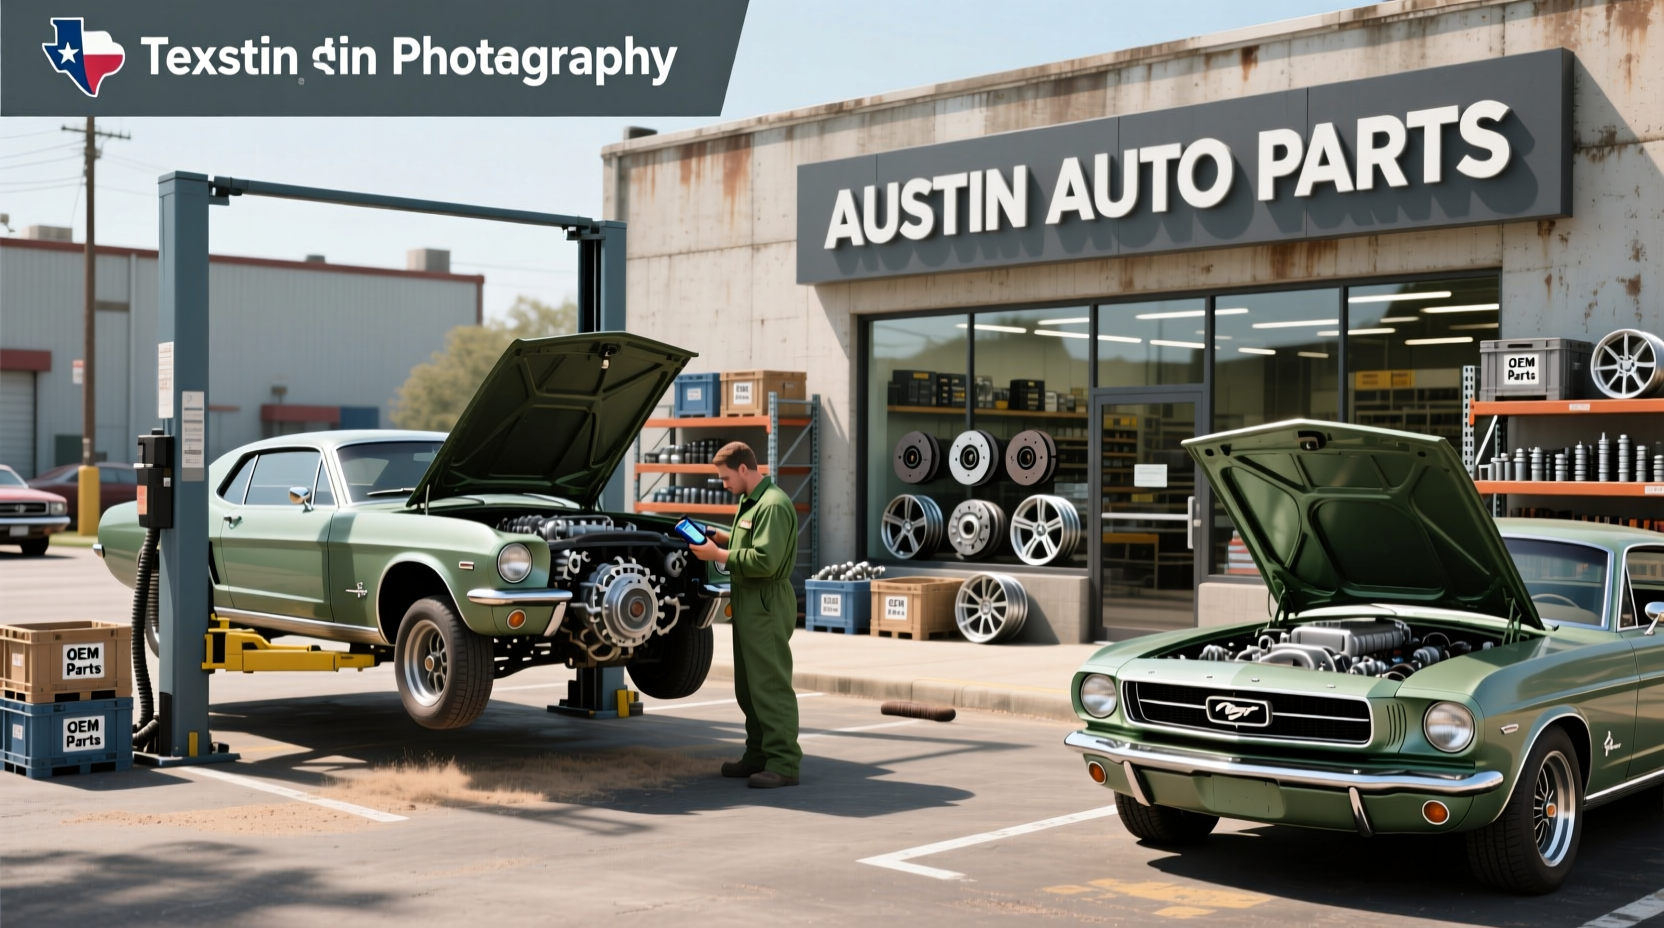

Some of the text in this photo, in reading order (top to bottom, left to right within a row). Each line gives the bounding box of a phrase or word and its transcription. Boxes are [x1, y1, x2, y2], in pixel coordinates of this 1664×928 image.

[824, 100, 1512, 250] AUSTIN AUTO PARTS
[1508, 357, 1535, 368] OEM
[1508, 370, 1536, 381] Parts
[67, 647, 99, 661] OEM
[67, 662, 101, 676] Parts
[67, 719, 99, 733] OEM
[67, 734, 101, 748] Parts
